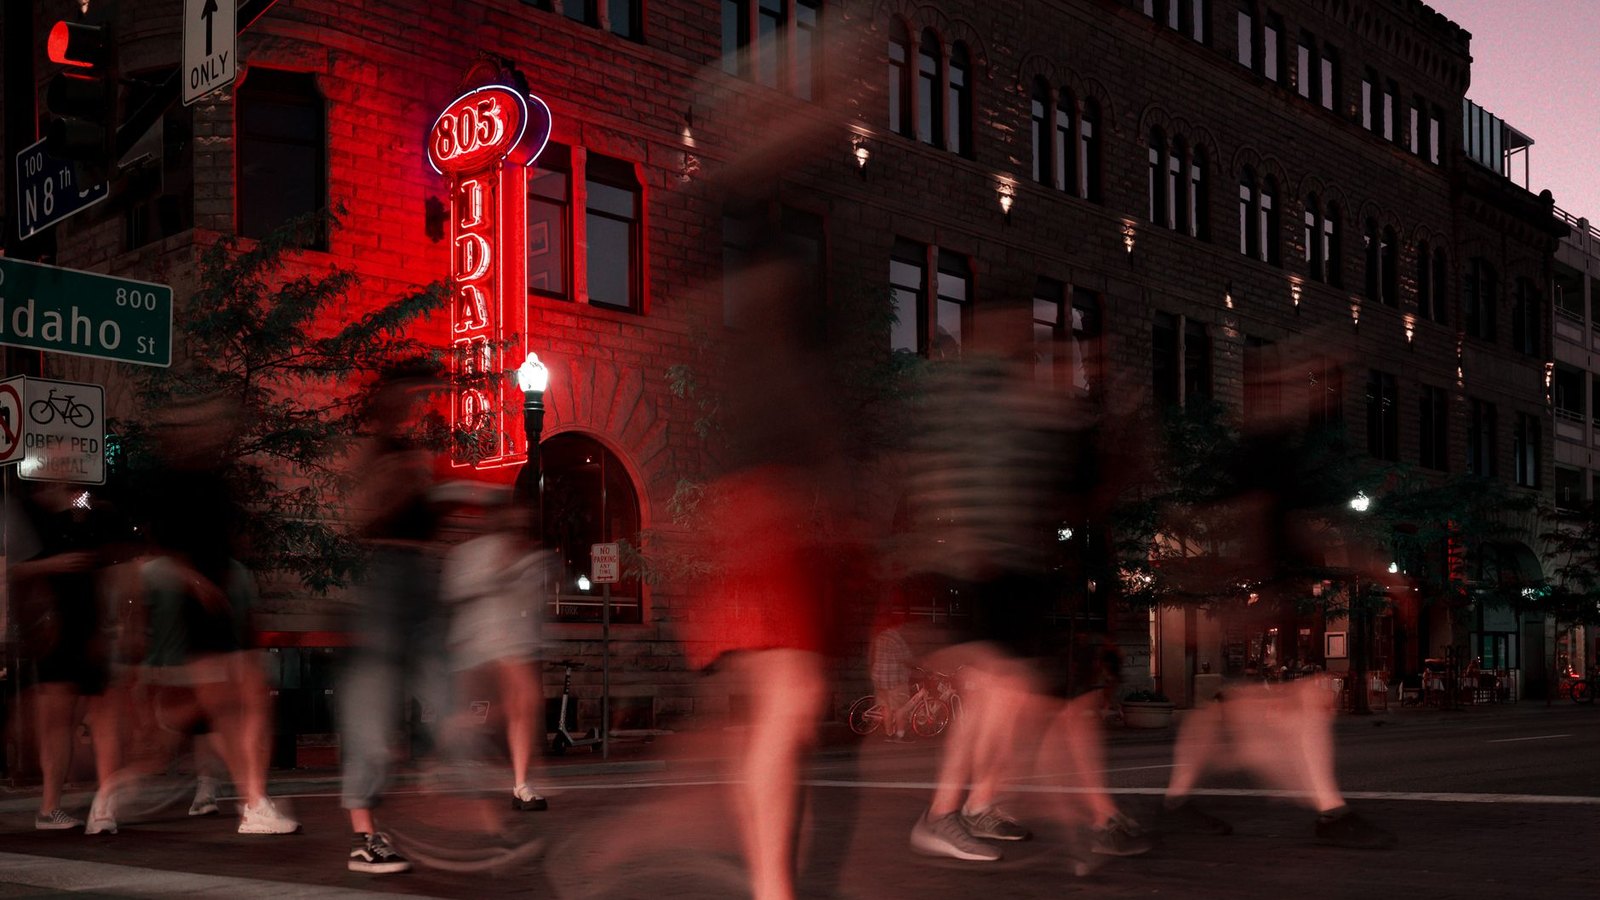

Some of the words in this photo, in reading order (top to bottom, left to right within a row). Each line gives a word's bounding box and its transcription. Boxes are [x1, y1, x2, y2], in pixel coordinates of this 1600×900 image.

[190, 50, 228, 90] ONLY
[436, 97, 503, 161] 805
[25, 151, 43, 179] 100
[25, 184, 38, 227] N
[43, 176, 54, 216] 8
[115, 287, 156, 311] 800
[136, 335, 155, 355] St
[25, 432, 64, 449] OBEY
[71, 437, 98, 453] PED
[36, 456, 88, 474] SIGNAL
[593, 556, 617, 564] PARKING
[600, 547, 610, 555] NO
